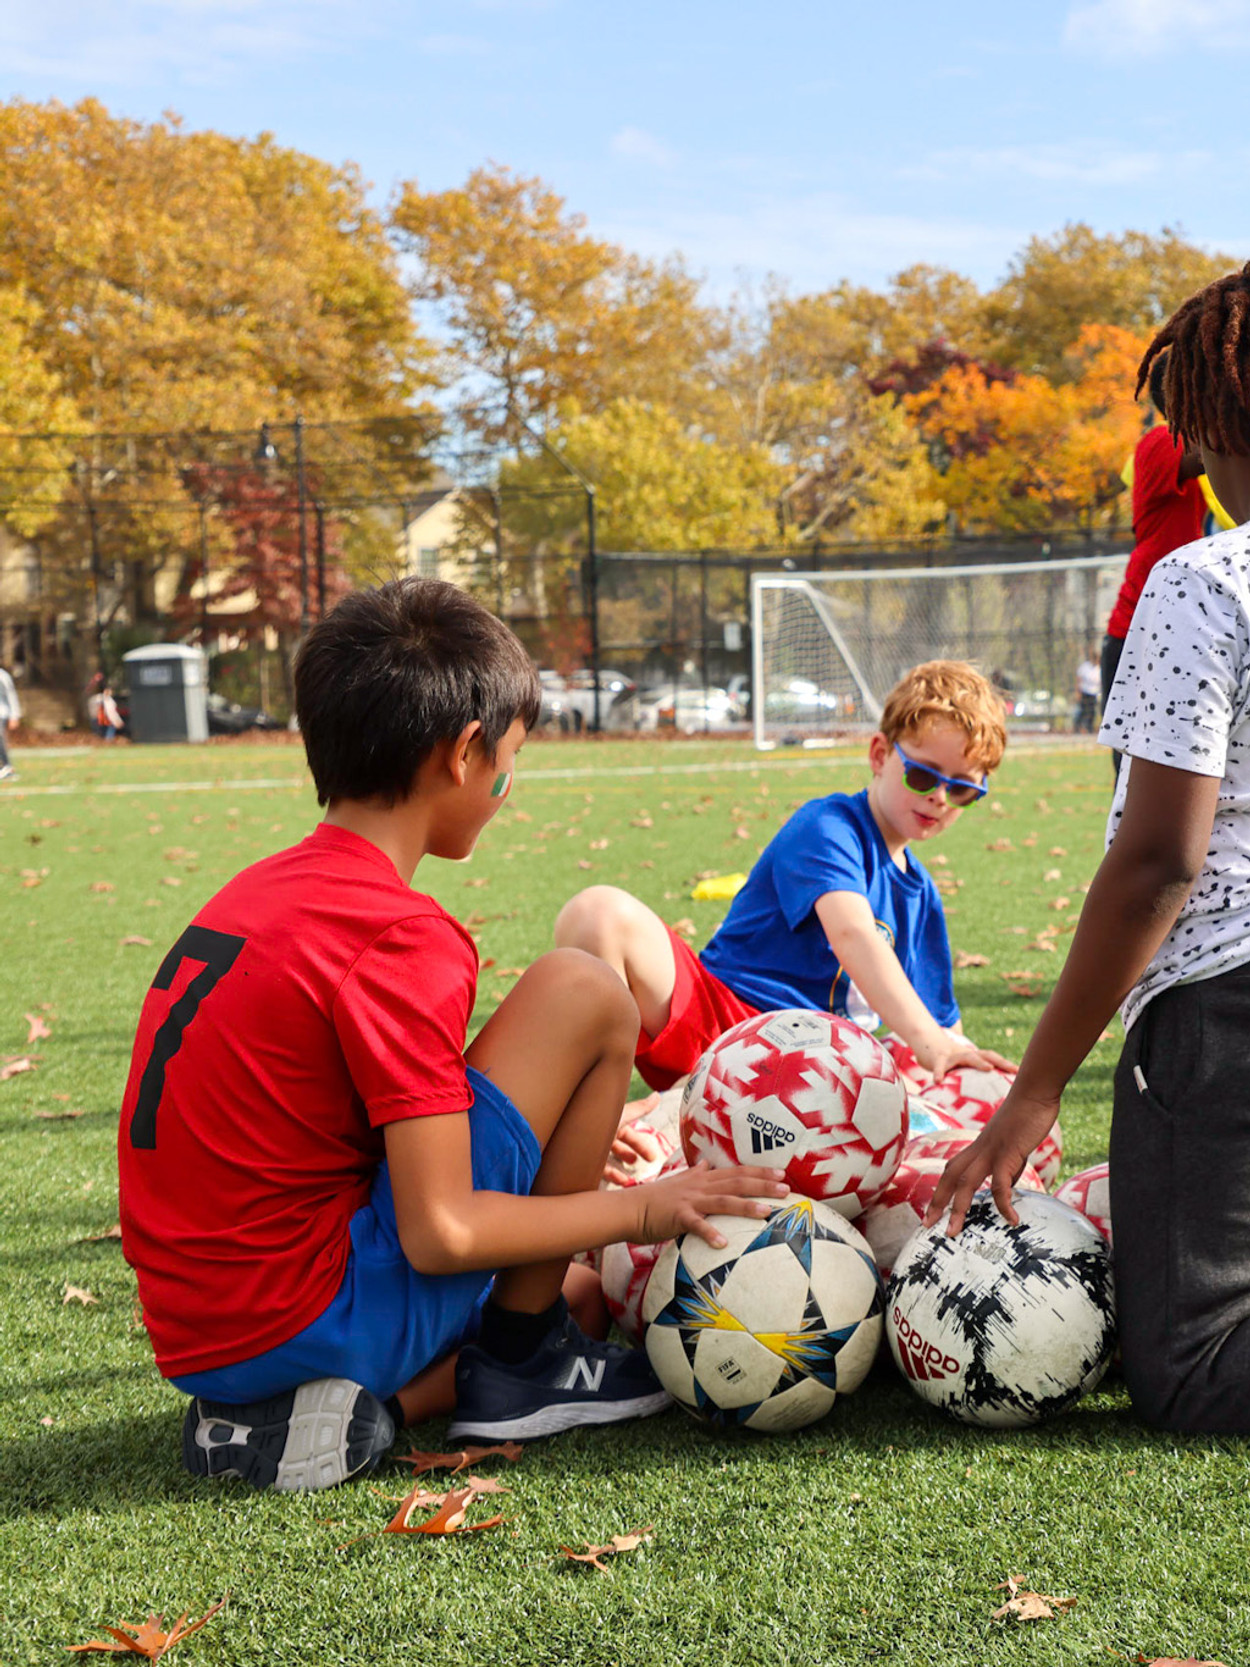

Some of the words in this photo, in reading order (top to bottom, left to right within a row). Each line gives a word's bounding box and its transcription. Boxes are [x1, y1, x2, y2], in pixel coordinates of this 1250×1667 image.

[130, 925, 247, 1149] 7
[746, 1112, 796, 1143] adidas
[893, 1306, 960, 1374] adidas
[558, 1356, 606, 1392] N
